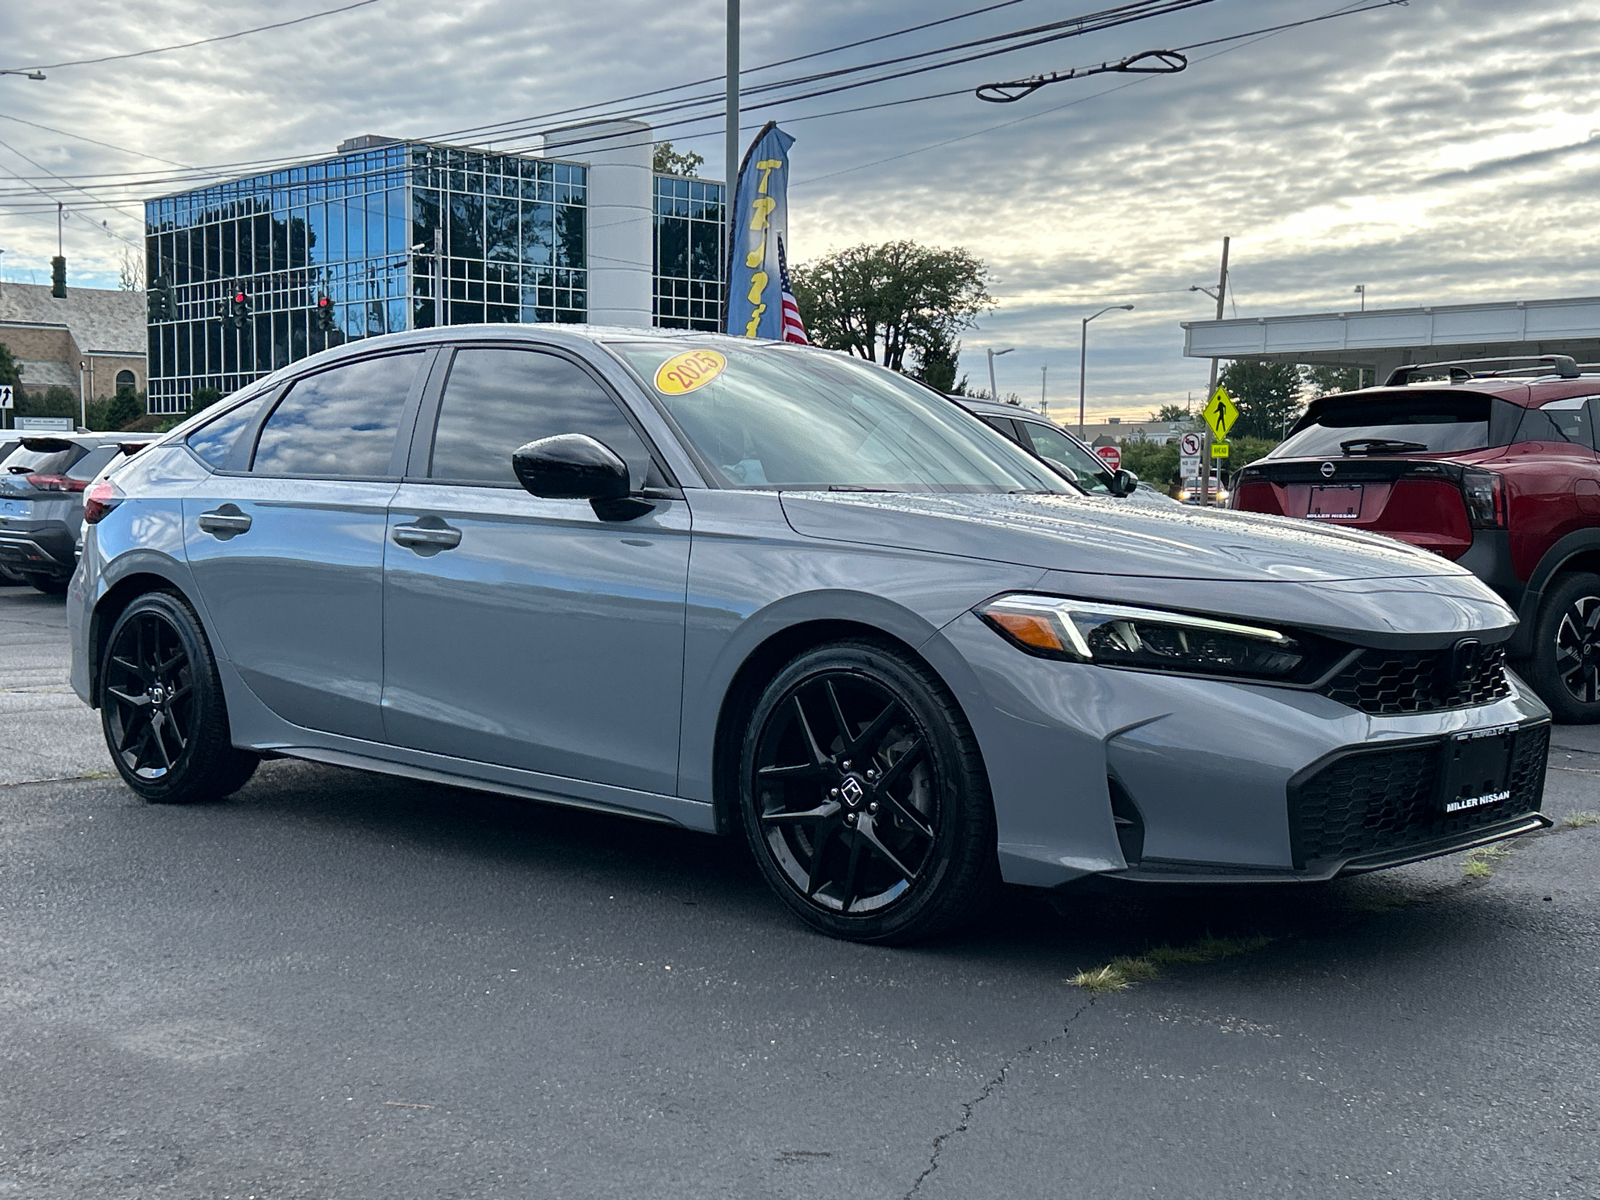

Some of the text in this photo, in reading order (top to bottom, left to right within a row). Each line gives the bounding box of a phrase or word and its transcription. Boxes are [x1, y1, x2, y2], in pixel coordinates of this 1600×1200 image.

[667, 352, 719, 389] 2025
[1446, 790, 1510, 813] MILLER NISSAN
